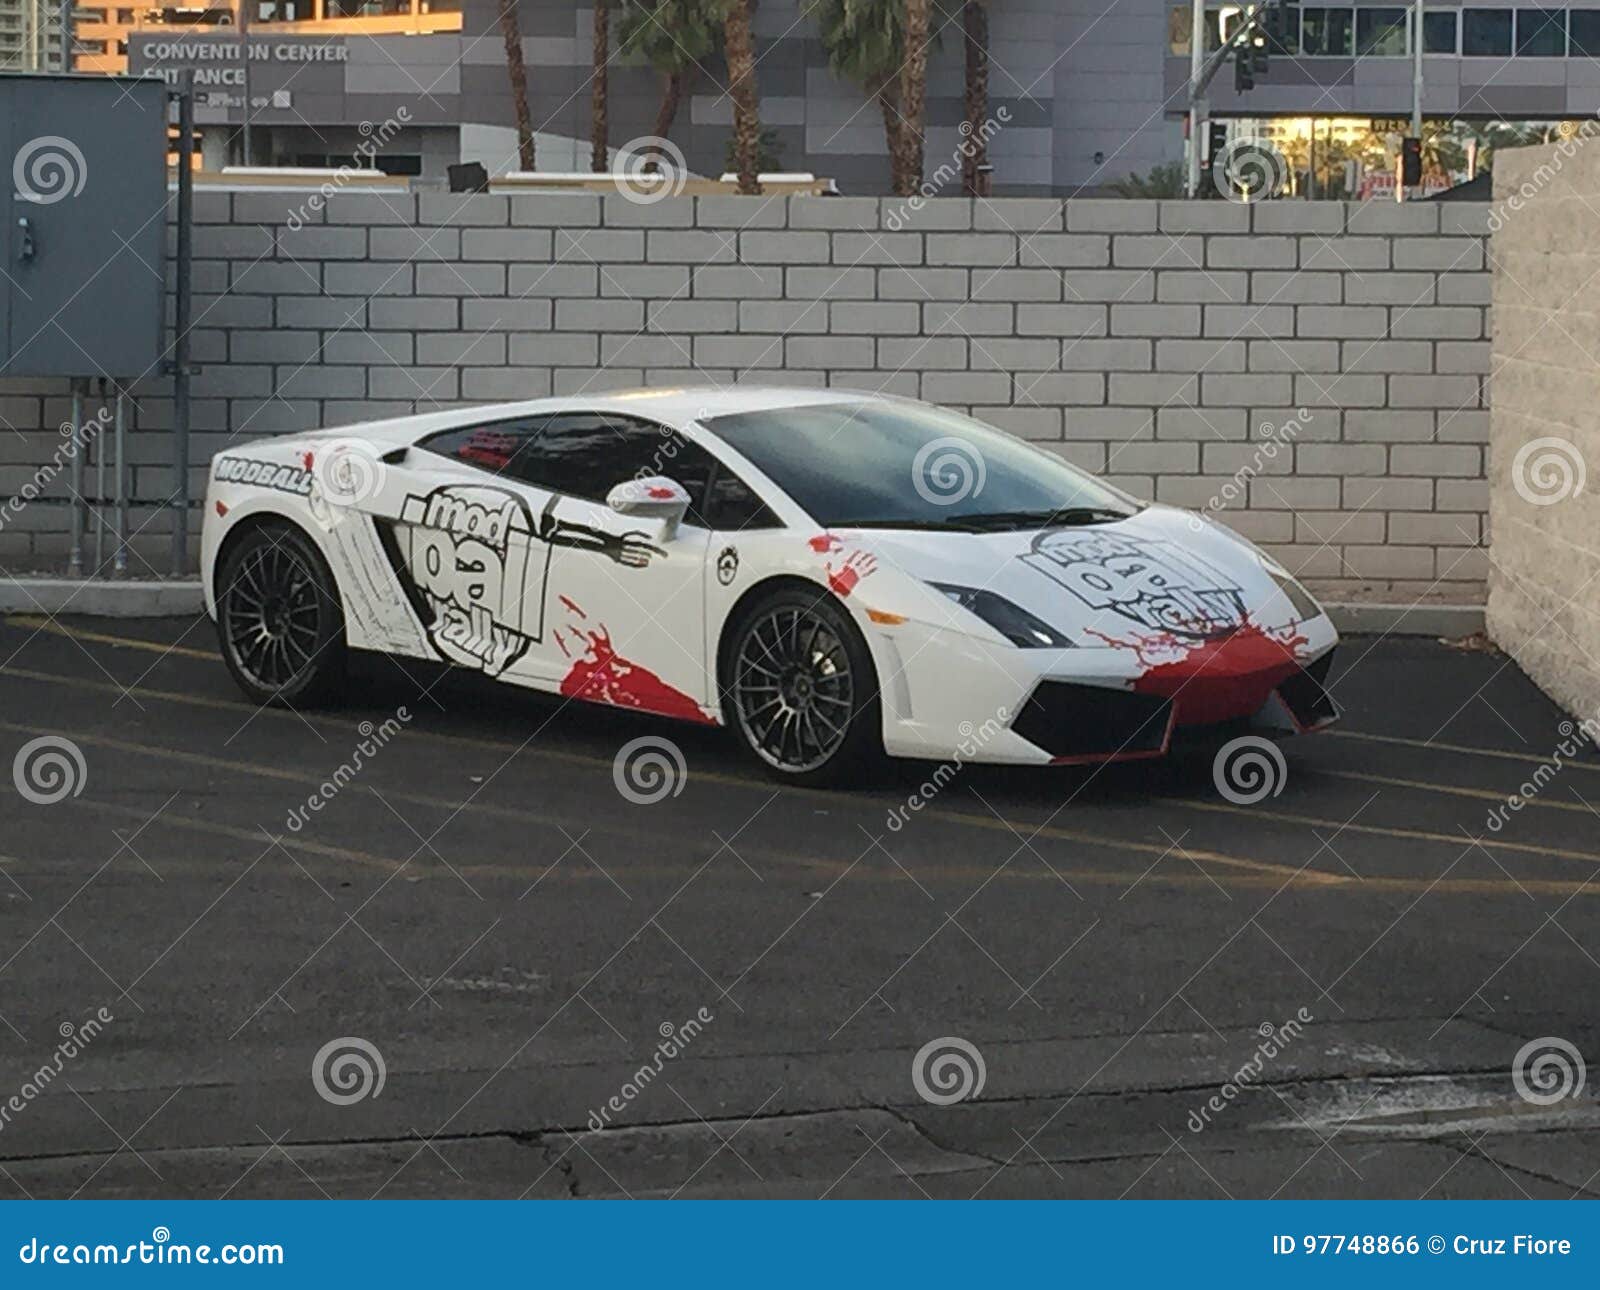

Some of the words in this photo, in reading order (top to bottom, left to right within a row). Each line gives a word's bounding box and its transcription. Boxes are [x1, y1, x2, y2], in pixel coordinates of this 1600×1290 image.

[275, 44, 349, 61] CENTER
[143, 68, 246, 84] ENTANCE
[214, 456, 313, 496] MODBALL
[424, 493, 518, 548] mod
